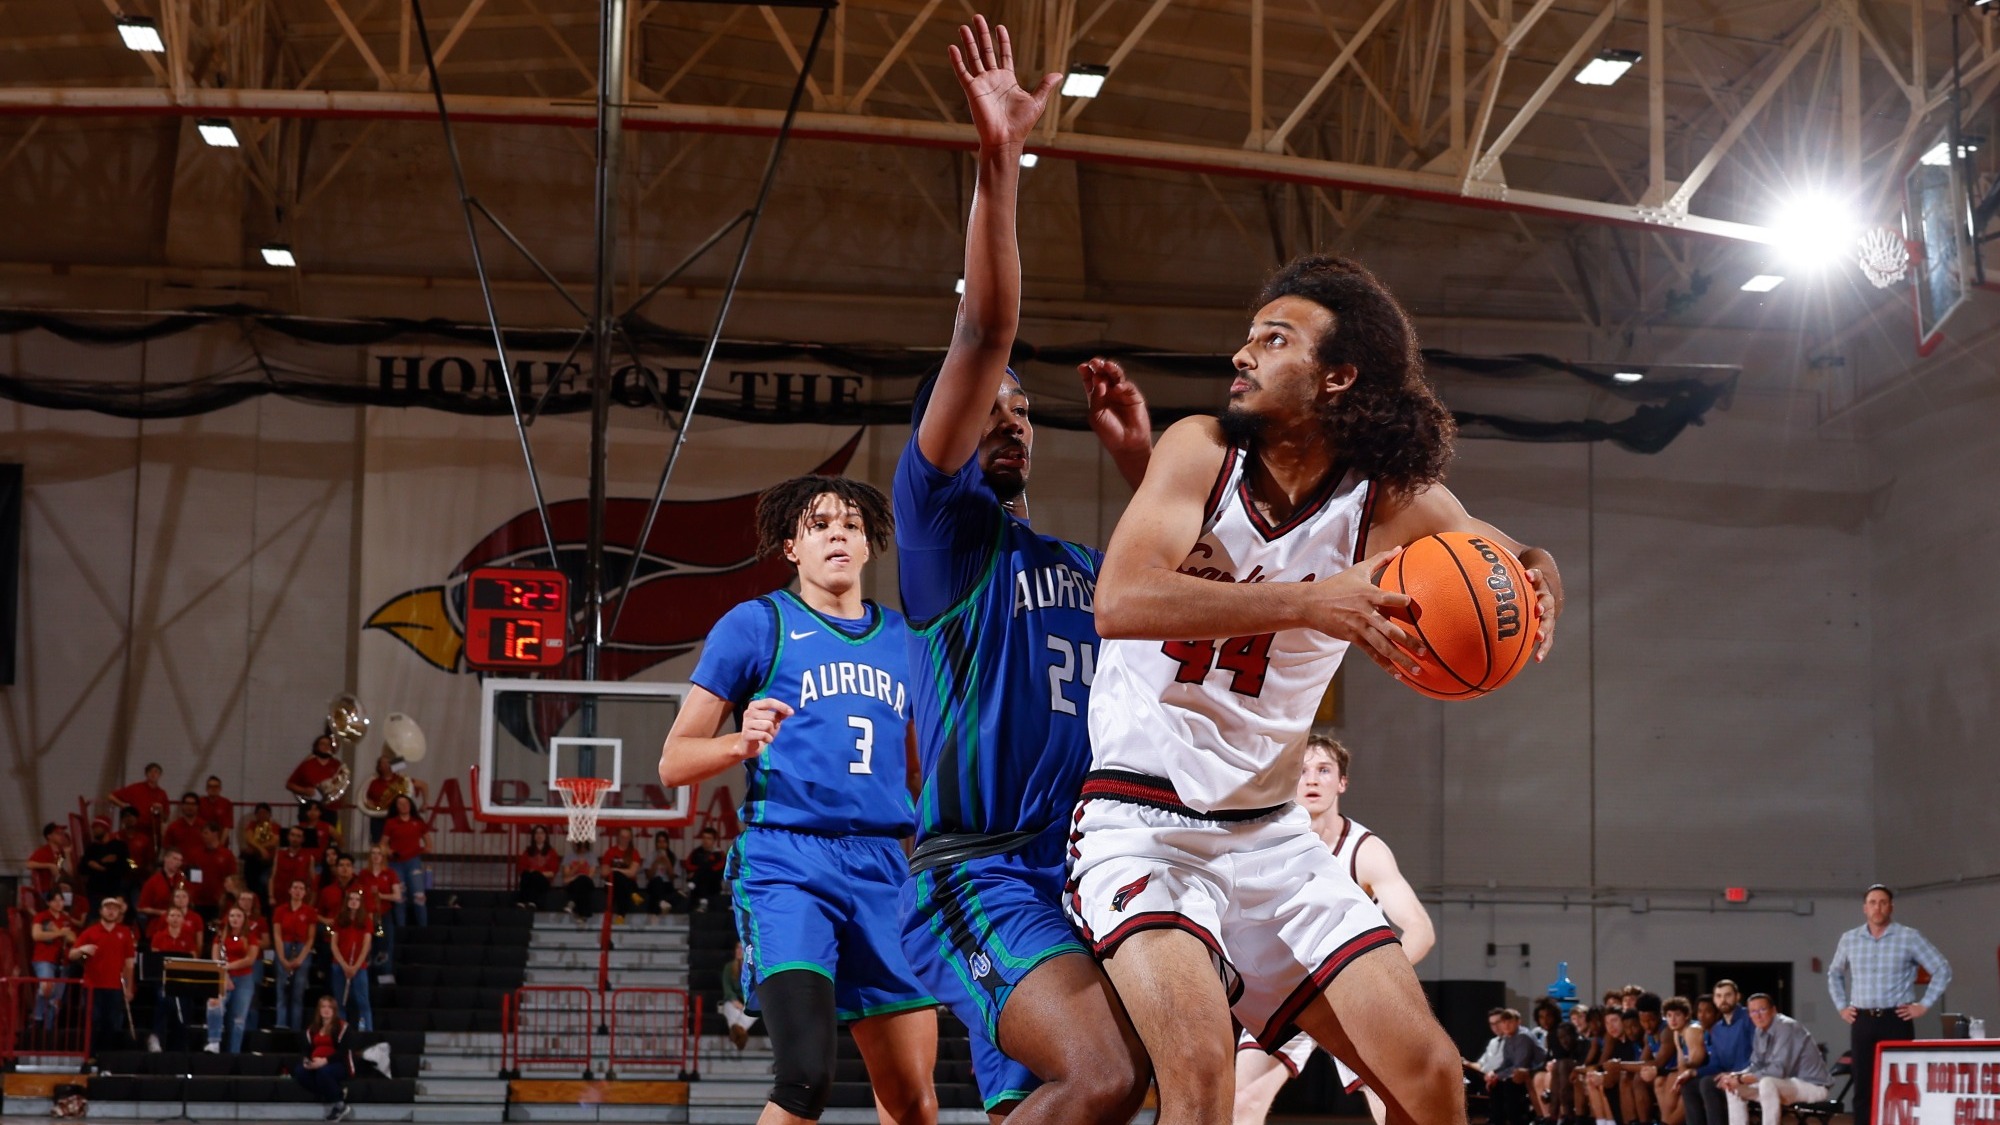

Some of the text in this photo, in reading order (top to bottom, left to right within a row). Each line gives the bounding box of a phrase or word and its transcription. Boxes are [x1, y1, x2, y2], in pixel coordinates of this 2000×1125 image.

[376, 355, 865, 414] HOME OF THE
[1013, 563, 1096, 618] AURO
[1467, 538, 1521, 642] Wilson
[505, 620, 541, 660] 12
[1161, 631, 1276, 698] 44
[799, 661, 905, 720] AURORA
[847, 715, 874, 775] 3
[426, 777, 741, 840] ARNA
[1926, 1062, 1978, 1093] NORTH
